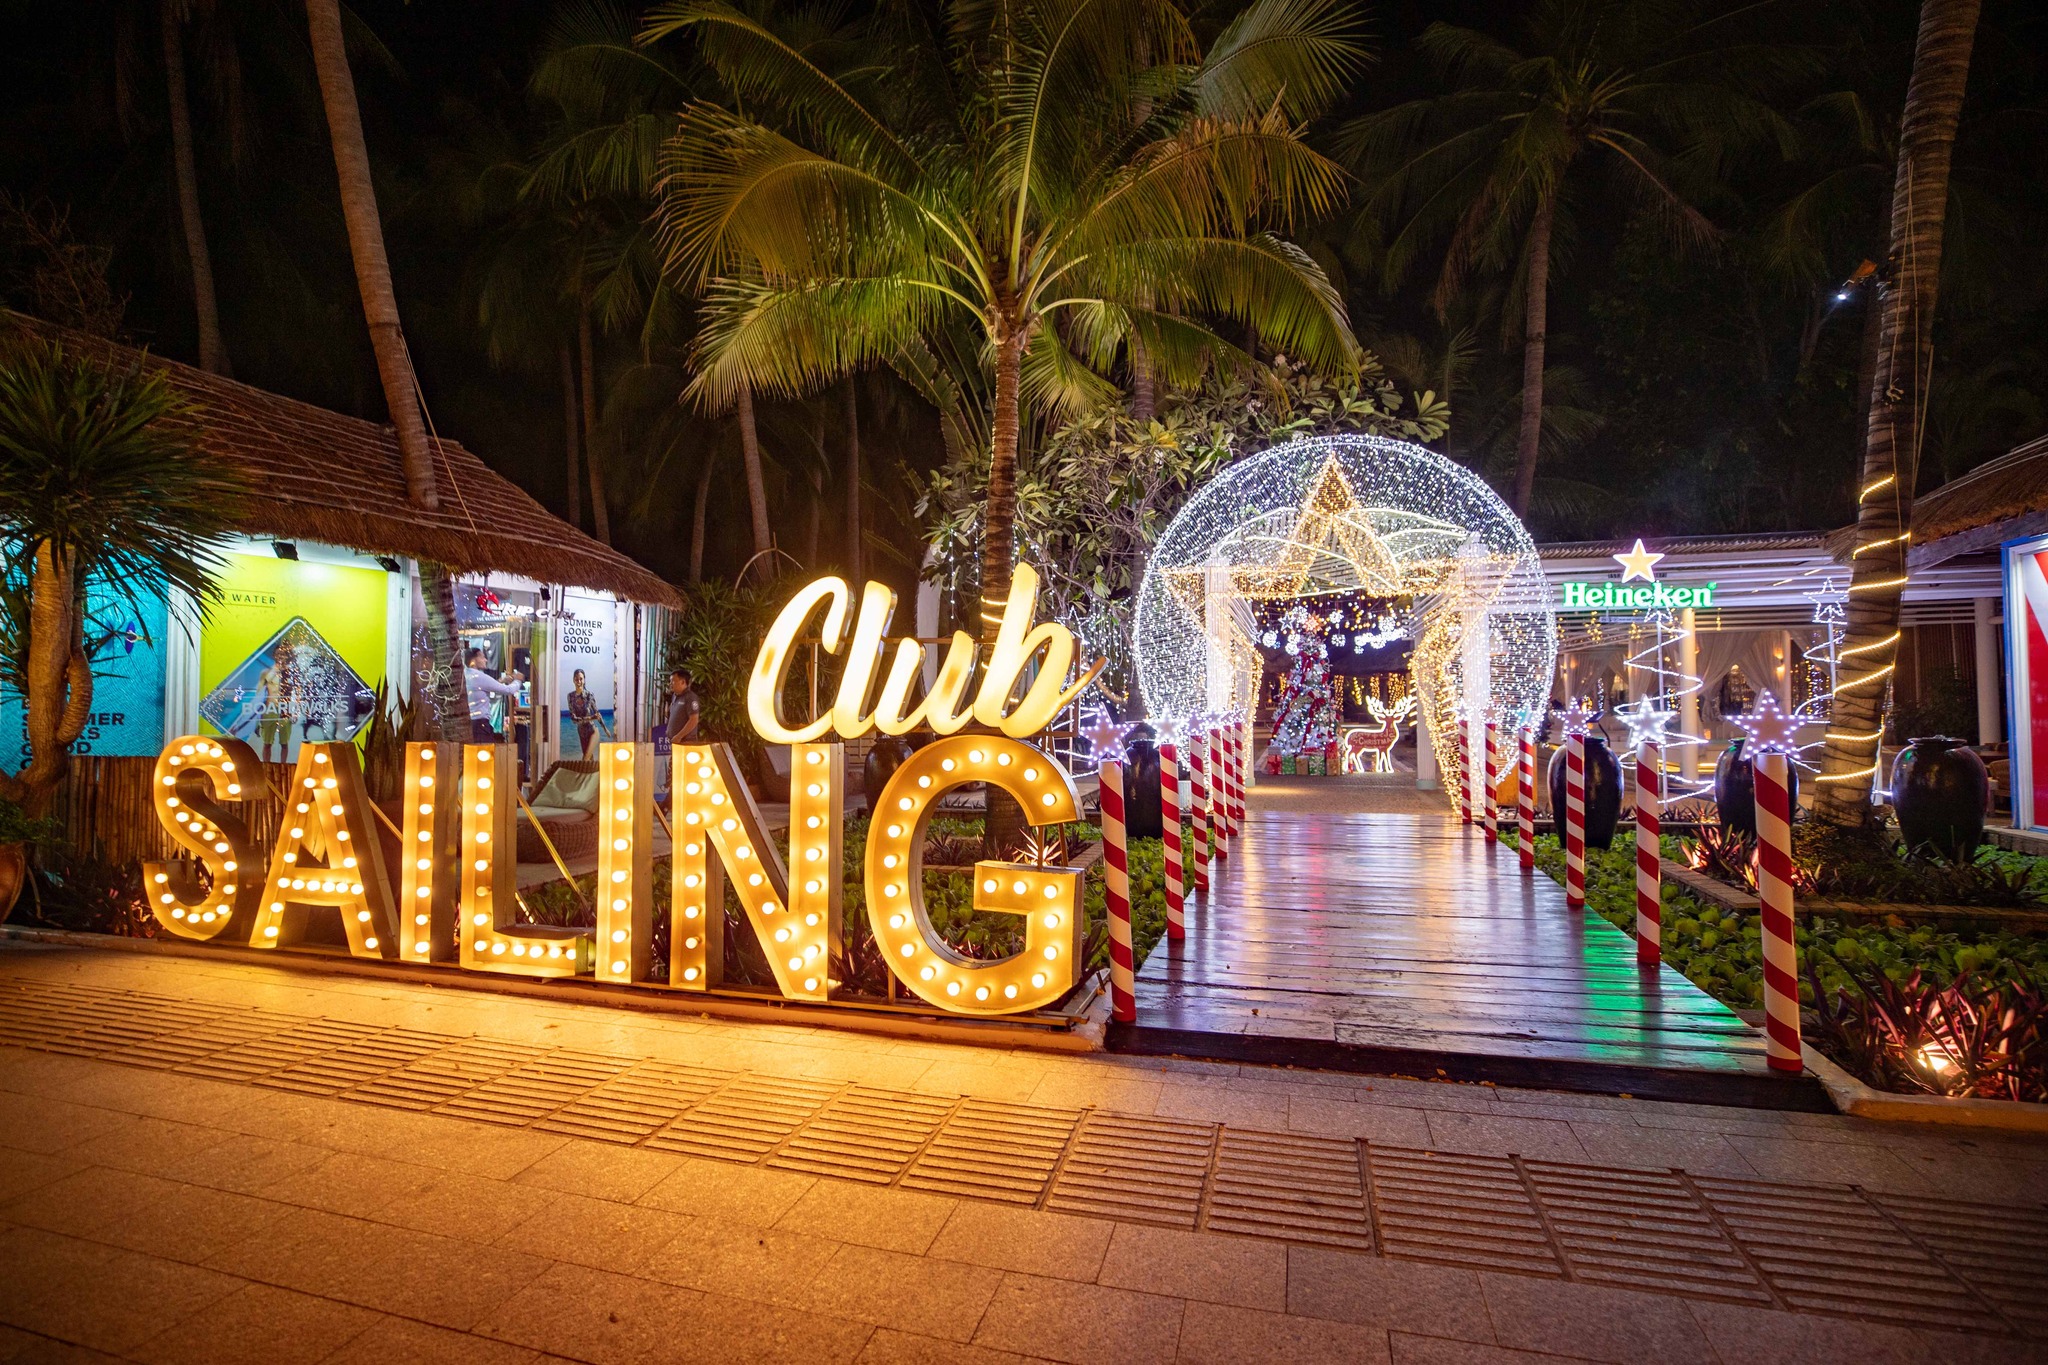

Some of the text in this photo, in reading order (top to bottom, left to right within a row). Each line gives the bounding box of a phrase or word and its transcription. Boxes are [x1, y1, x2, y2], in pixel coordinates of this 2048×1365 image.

[231, 594, 276, 604] WATER
[1563, 582, 1714, 608] Heineken
[502, 602, 535, 617] RIP
[563, 619, 602, 629] SUMMER
[563, 627, 593, 636] LOOKS
[563, 636, 590, 645] GOOD
[563, 644, 600, 654] ON YOU!
[747, 562, 1109, 744] Club
[242, 700, 349, 715] BOARDWALKS
[143, 734, 1085, 1015] SAILING
